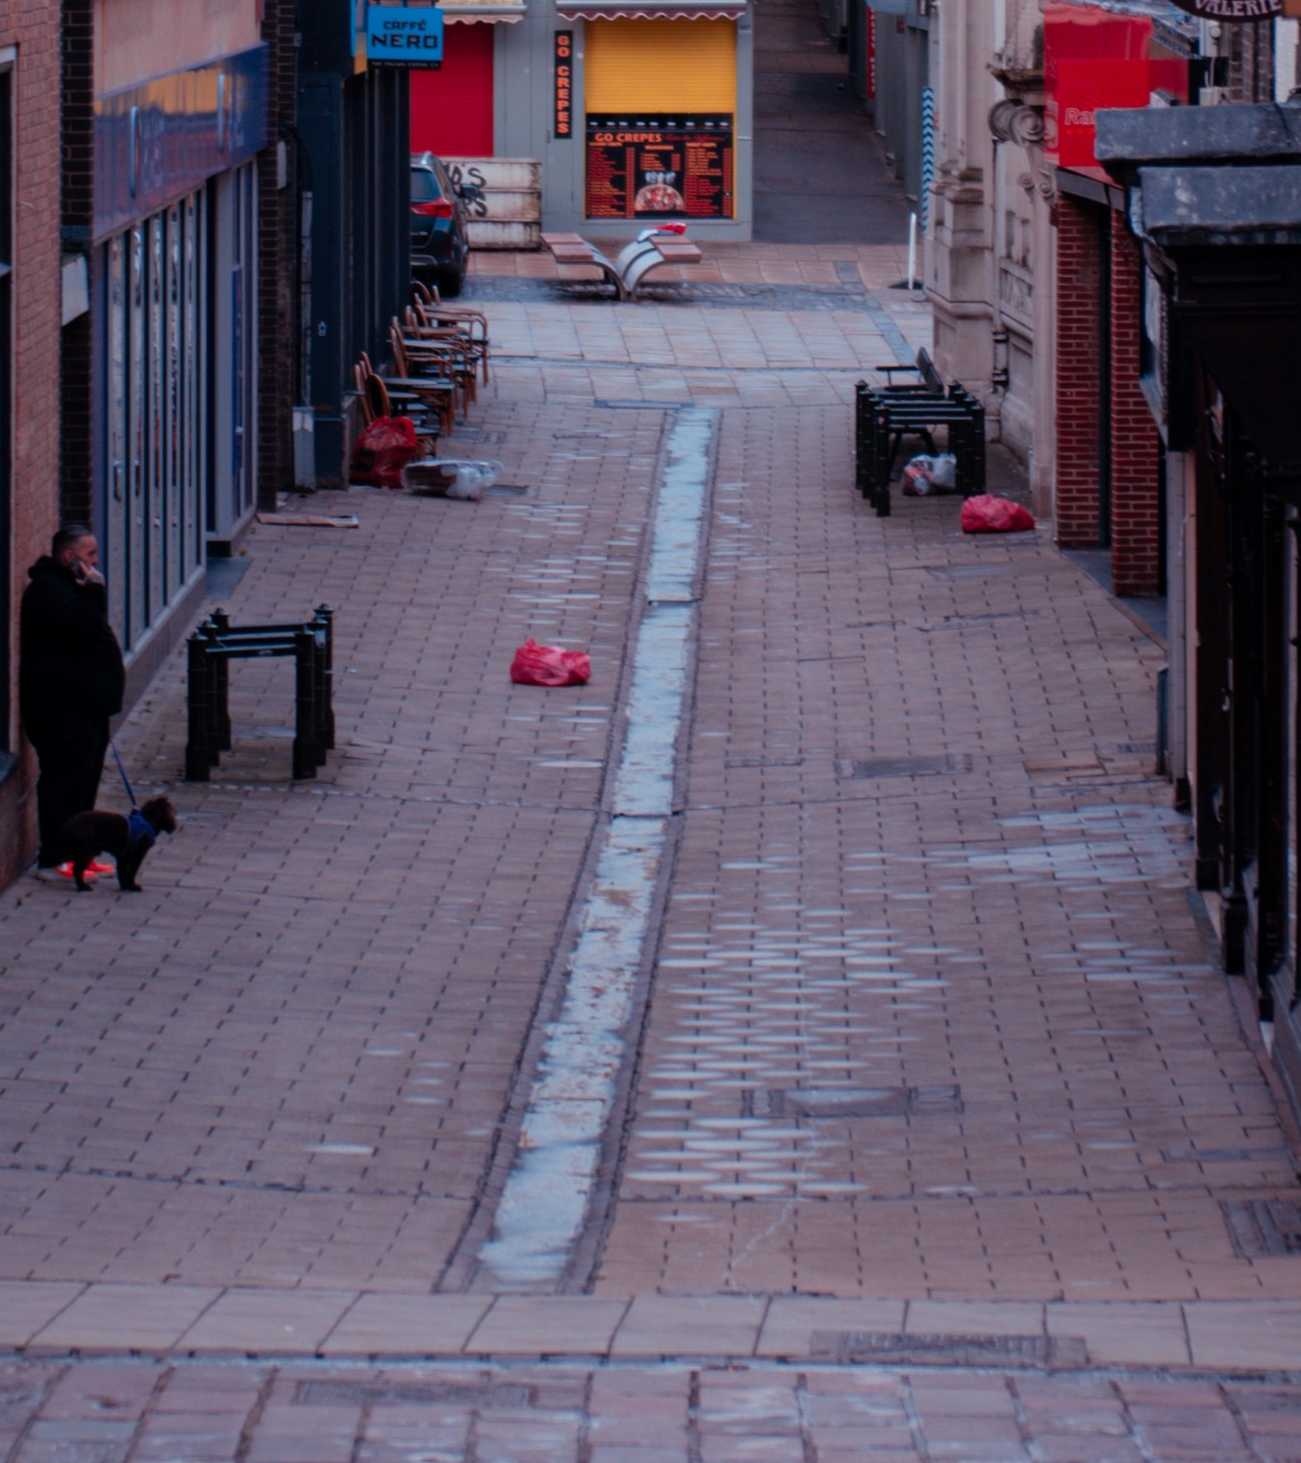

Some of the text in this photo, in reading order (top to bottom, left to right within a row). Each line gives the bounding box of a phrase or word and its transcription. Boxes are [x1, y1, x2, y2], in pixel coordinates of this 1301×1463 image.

[372, 34, 438, 49] NERO
[557, 35, 570, 134] GO CREPES
[1064, 107, 1094, 126] Ra
[595, 133, 614, 143] GO
[616, 133, 662, 143] CREPES
